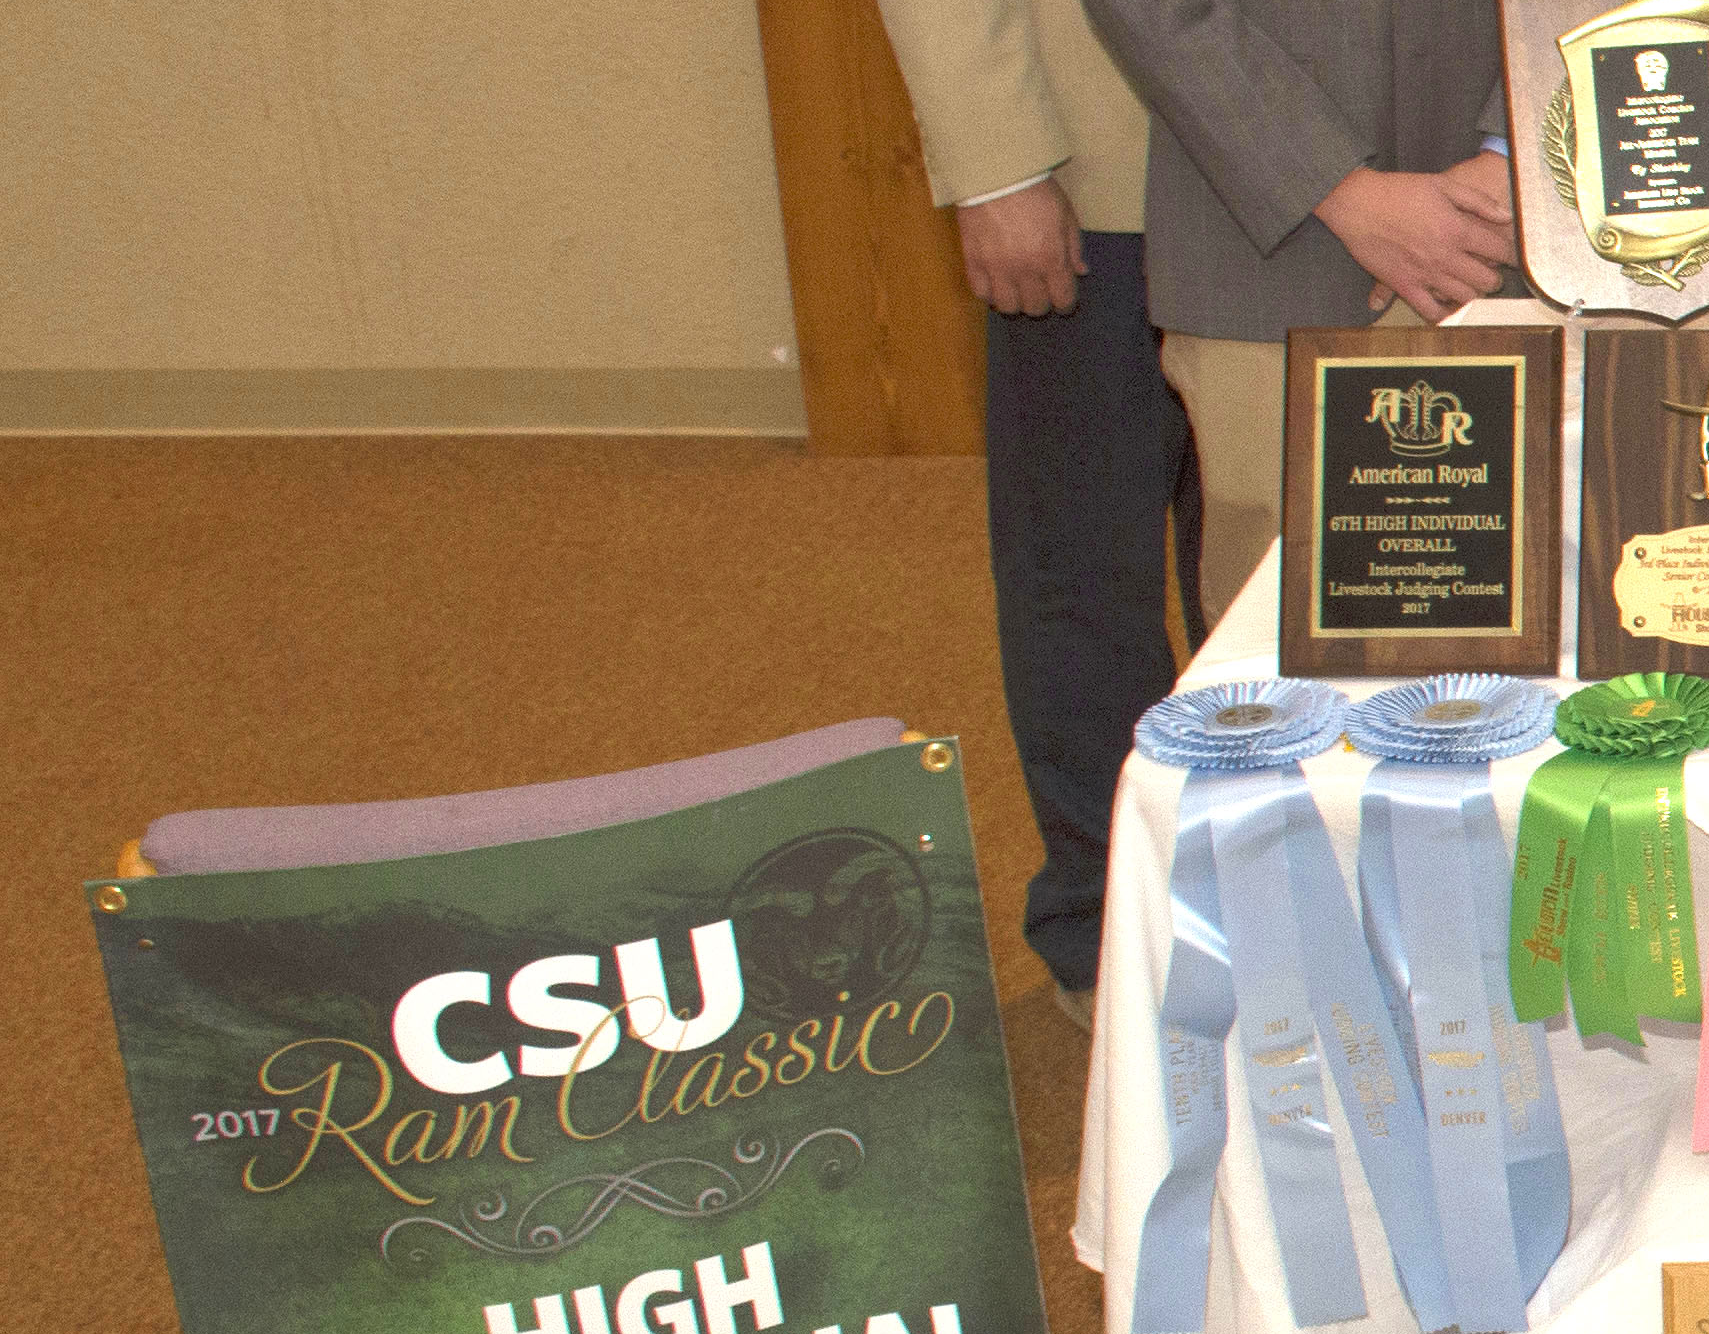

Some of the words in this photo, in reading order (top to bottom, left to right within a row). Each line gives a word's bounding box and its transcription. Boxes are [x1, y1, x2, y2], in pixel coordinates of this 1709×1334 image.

[1350, 466, 1432, 485] American
[1438, 464, 1488, 488] Royal
[1365, 516, 1407, 531] HIGH
[1410, 515, 1506, 530] INDIVIDUAL
[1378, 539, 1456, 552] OVERALL
[392, 919, 744, 1094] CSU
[192, 1110, 280, 1142] 2017
[243, 1038, 536, 1205] Ram
[557, 991, 954, 1140] Classic
